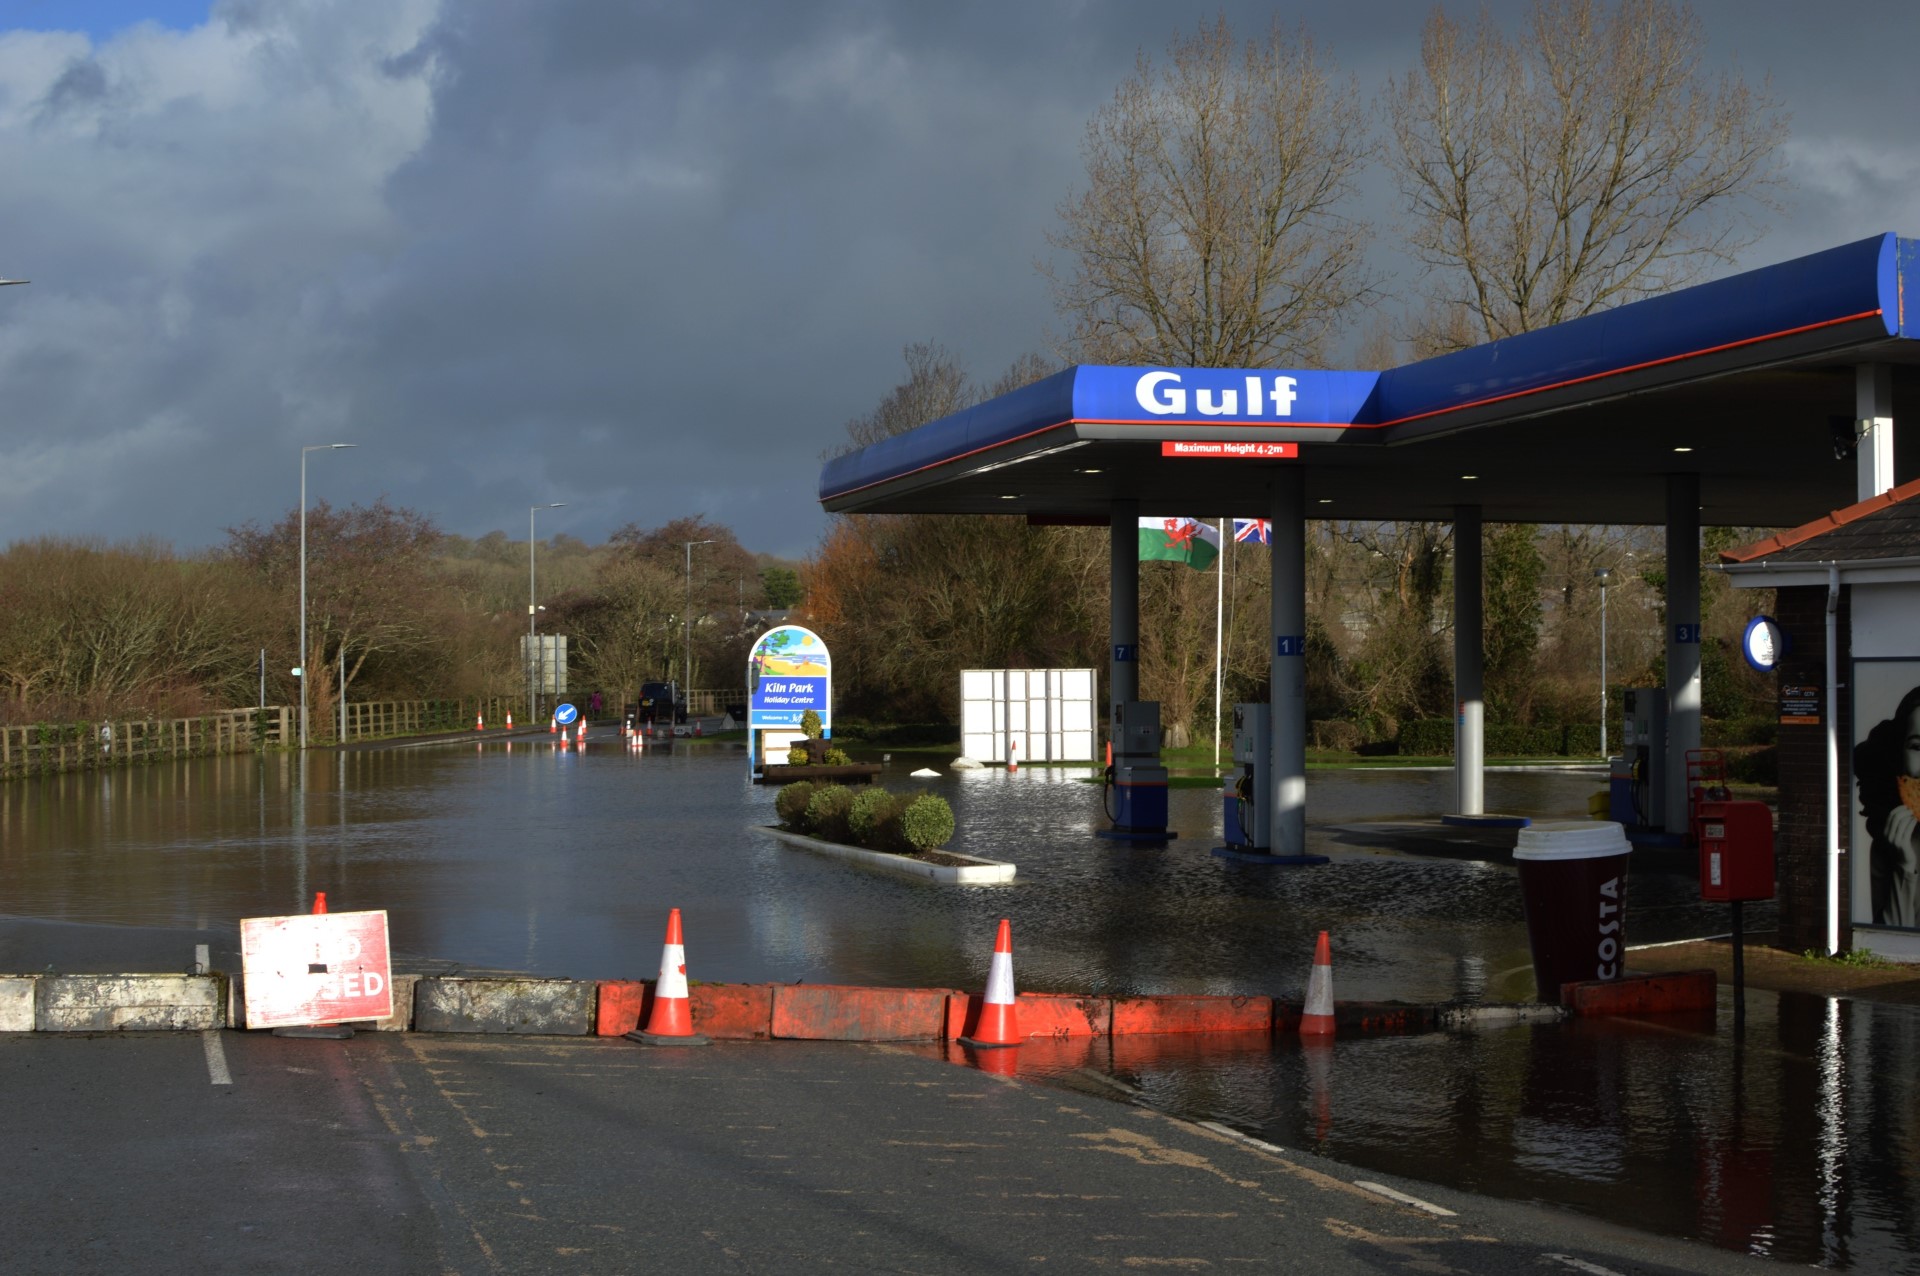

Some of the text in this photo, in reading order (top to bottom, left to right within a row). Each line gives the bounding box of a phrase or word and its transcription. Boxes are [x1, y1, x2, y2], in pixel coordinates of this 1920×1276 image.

[1135, 371, 1298, 417] Gulf
[1174, 442, 1221, 453] Maximum
[1223, 443, 1256, 455] Height
[1679, 626, 1688, 641] 3
[1281, 638, 1289, 653] 1
[1117, 647, 1125, 660] 7
[765, 682, 814, 693] Kiln Park
[763, 696, 815, 704] Holiday Centre
[1597, 876, 1619, 981] COSTA
